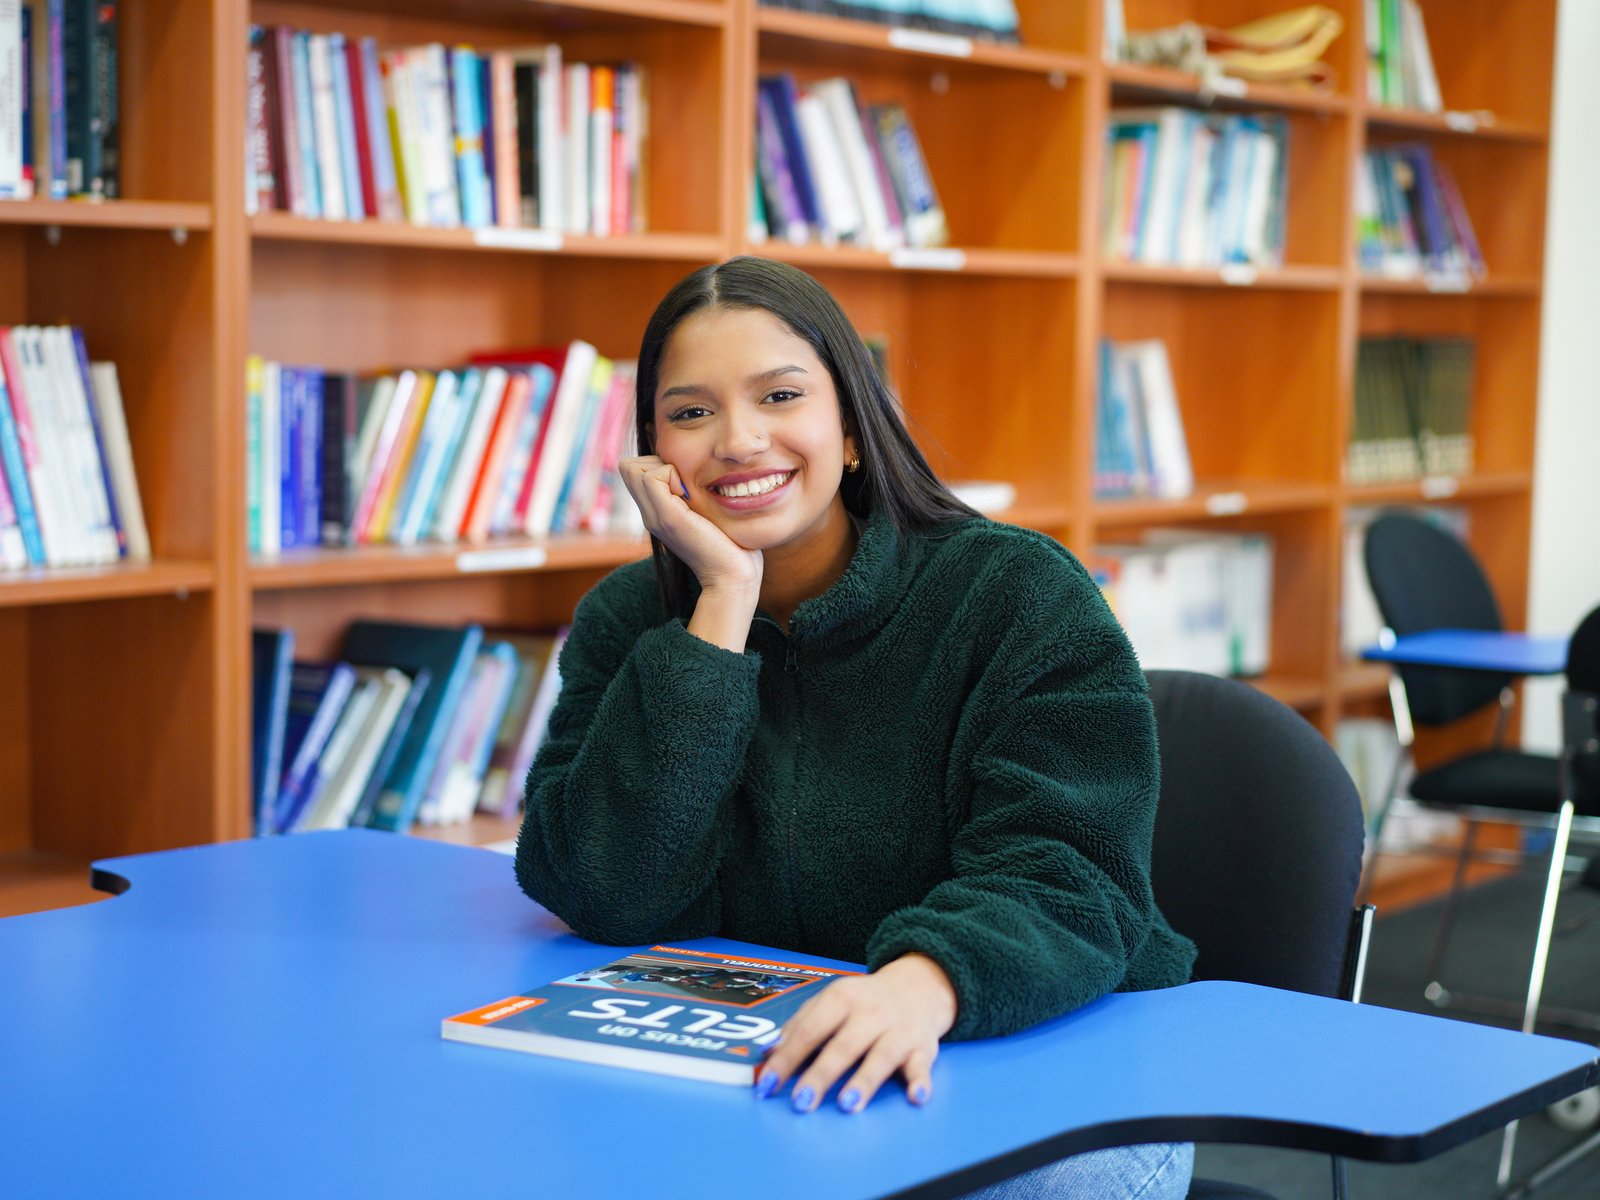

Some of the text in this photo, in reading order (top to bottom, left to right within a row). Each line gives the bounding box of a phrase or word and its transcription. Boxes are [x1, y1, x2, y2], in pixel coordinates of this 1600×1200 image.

[658, 946, 706, 956] PEARSON
[802, 969, 835, 977] SUE
[567, 998, 782, 1045] IELTS
[639, 1030, 728, 1050] FOCUS
